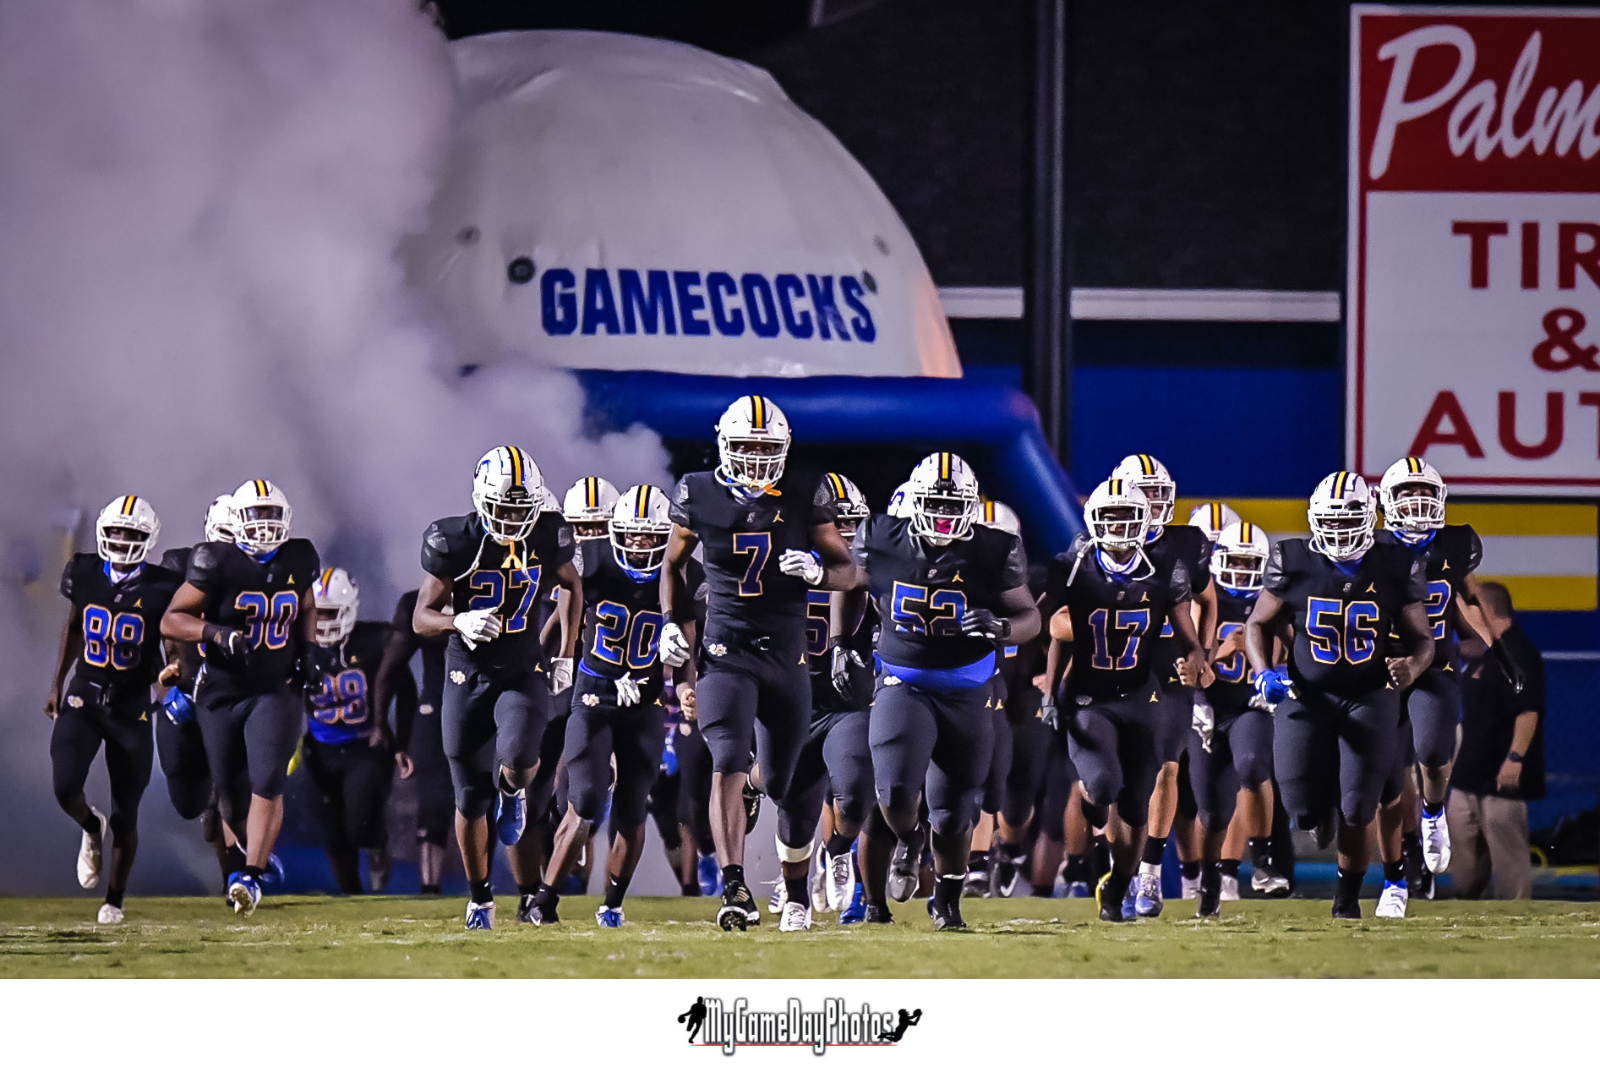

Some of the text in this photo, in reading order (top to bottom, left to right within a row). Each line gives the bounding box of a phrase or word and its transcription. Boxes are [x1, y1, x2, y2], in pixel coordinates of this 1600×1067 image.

[1451, 221, 1600, 289] TIR
[540, 268, 877, 343] GAMECOCKS
[733, 532, 772, 596] 7
[234, 590, 299, 650] 30
[469, 565, 542, 633] 27
[890, 580, 968, 637] 52
[1305, 596, 1379, 665] 56
[83, 603, 144, 670] 88
[591, 600, 664, 669] 20
[1088, 608, 1150, 670] 17
